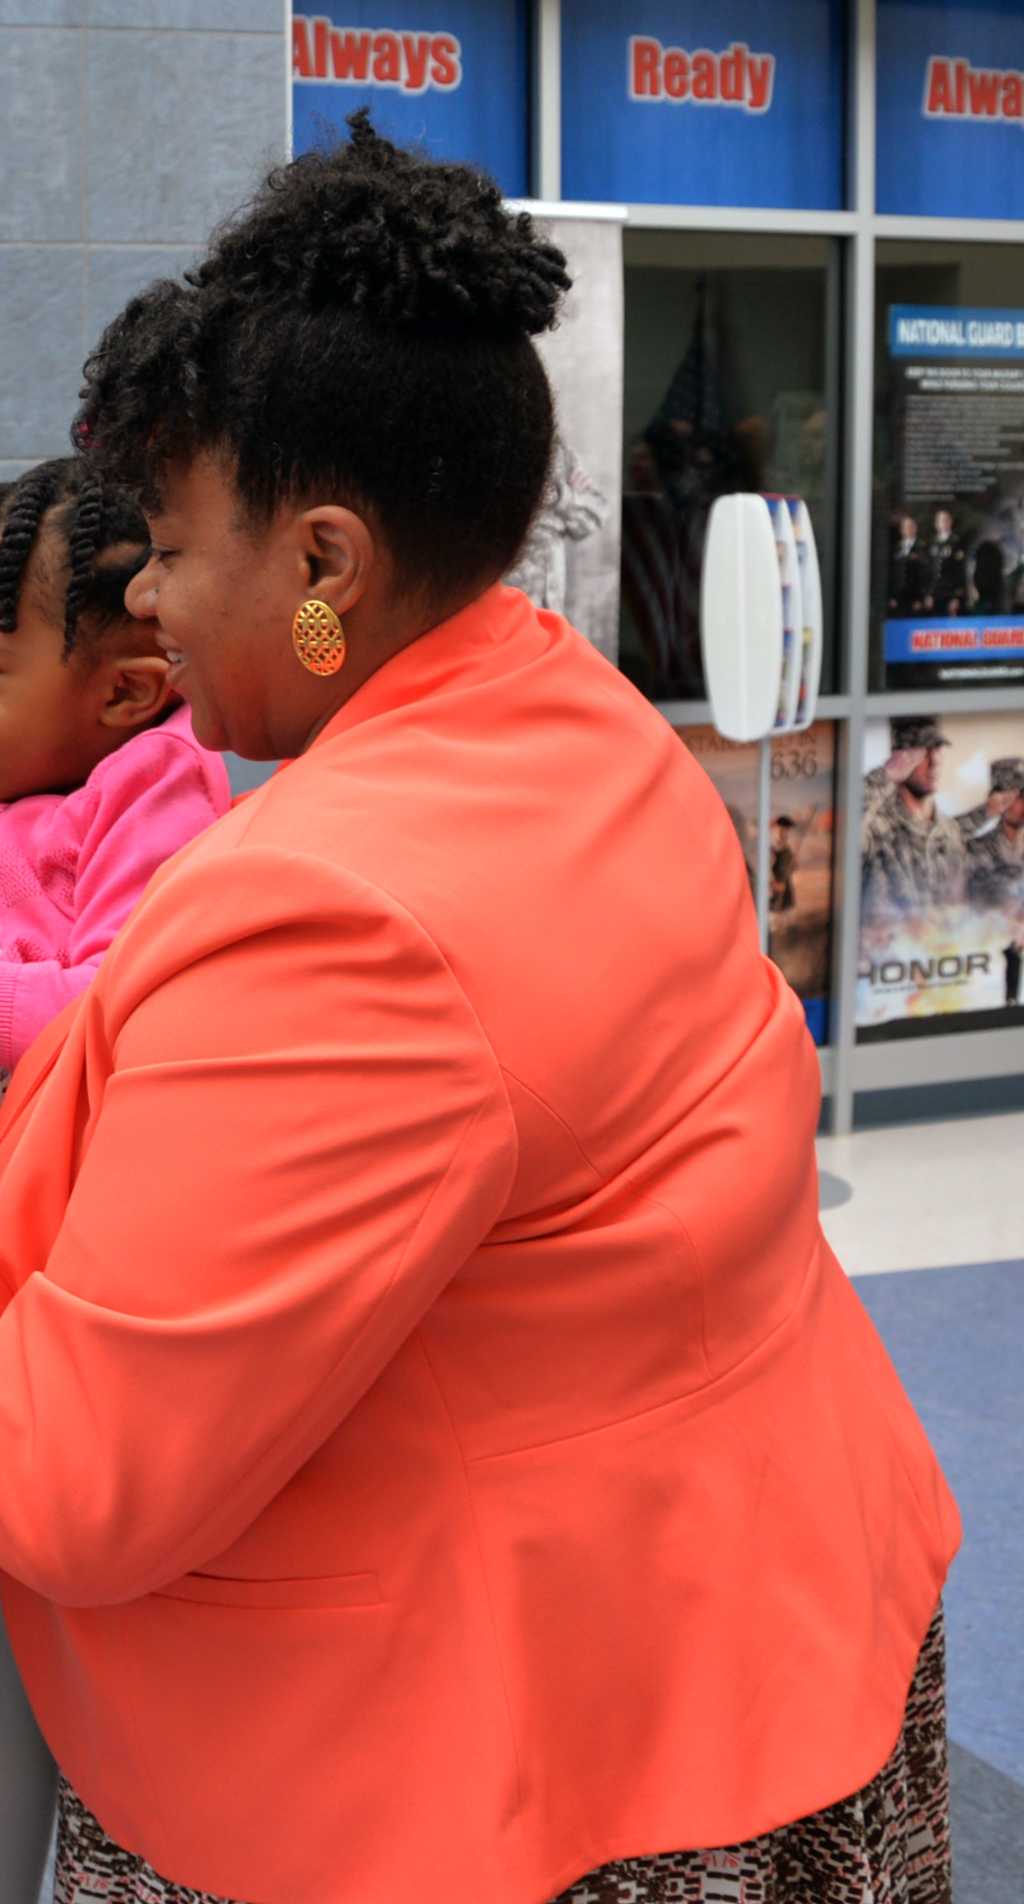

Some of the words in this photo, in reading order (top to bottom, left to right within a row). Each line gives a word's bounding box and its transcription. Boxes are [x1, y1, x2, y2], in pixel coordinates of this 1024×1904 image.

[292, 16, 460, 93] Always
[631, 36, 773, 112] Ready
[898, 318, 966, 346] NATIONAL
[968, 320, 1014, 348] GUARD
[910, 629, 978, 652] NATIONAL
[858, 954, 990, 984] HONOR
